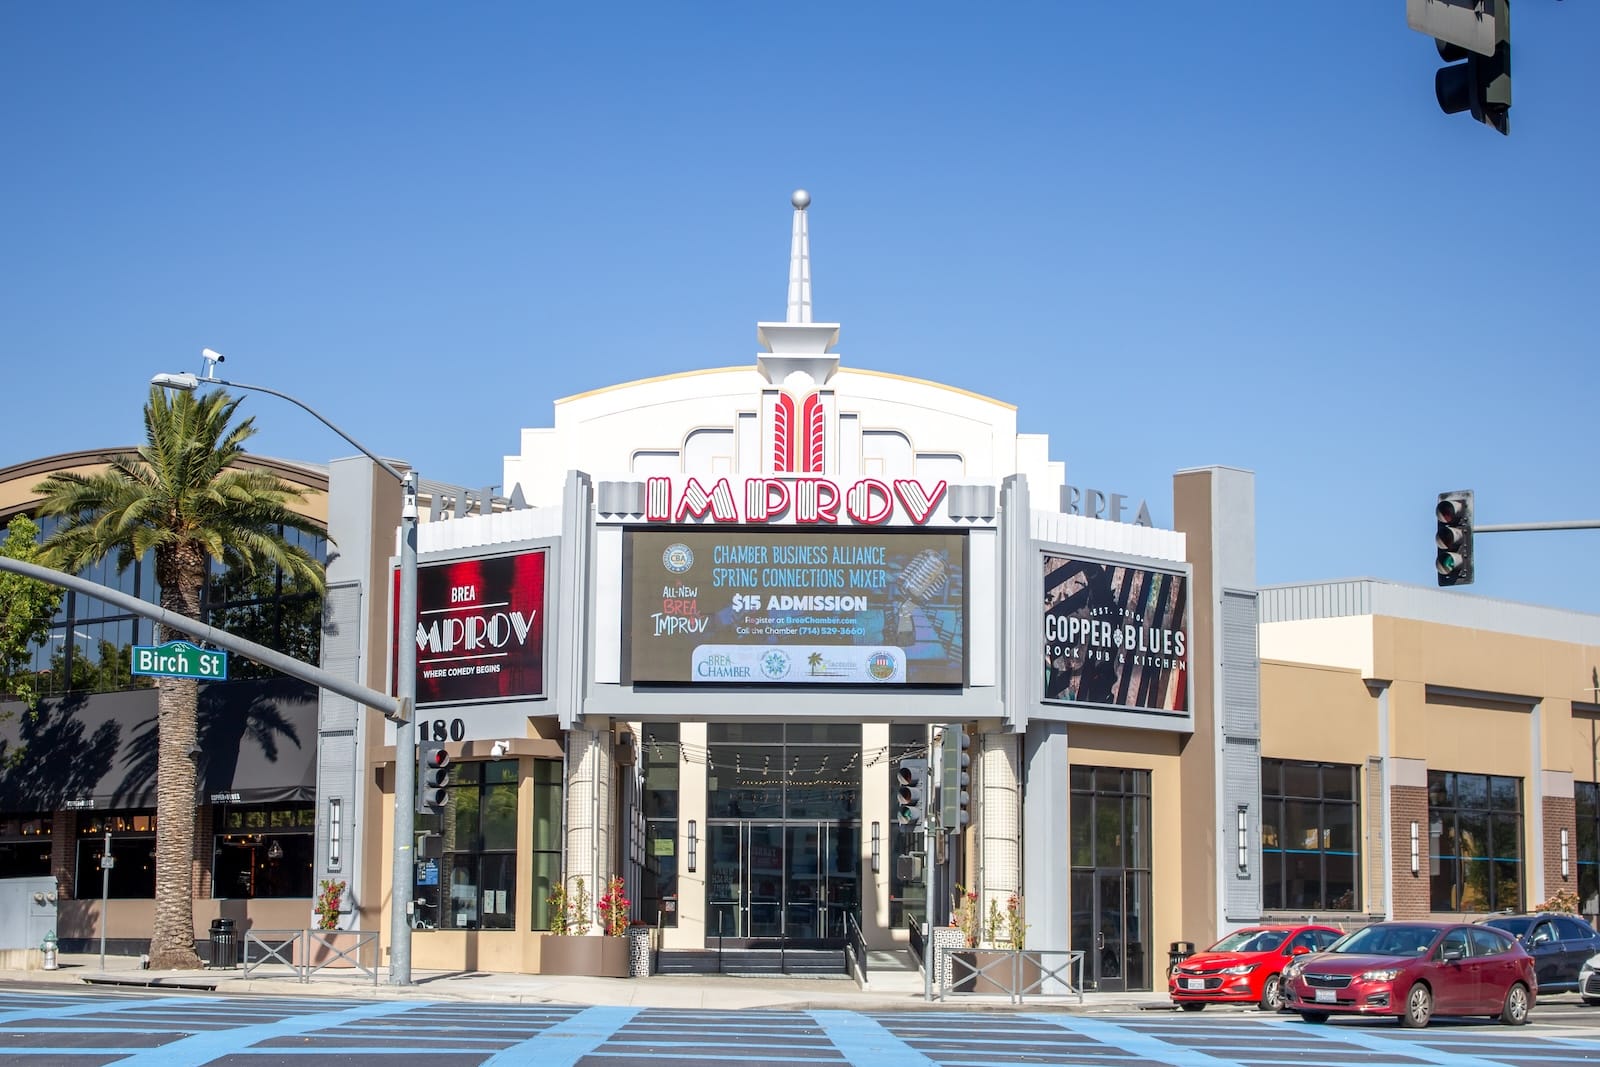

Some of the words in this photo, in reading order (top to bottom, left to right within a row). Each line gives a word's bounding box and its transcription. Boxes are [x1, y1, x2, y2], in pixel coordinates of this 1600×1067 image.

[646, 477, 947, 524] IMPROV
[713, 545, 768, 565] CHAMBER
[773, 545, 828, 565] BUSINESS
[832, 546, 886, 565] ALLIANCE
[712, 568, 757, 587] SPRING
[762, 568, 844, 588] CONNECTIONS
[850, 569, 886, 588] MIXER
[451, 585, 476, 603] BREA
[662, 585, 698, 598] ALL-NEW
[663, 599, 698, 615] BREA
[732, 593, 761, 612] $15
[766, 595, 868, 612] ADMISSION
[415, 609, 537, 653] MPROV
[764, 626, 798, 635] Chamber
[798, 627, 820, 635] (714)
[1045, 614, 1112, 648] COPPER
[1124, 624, 1185, 657] BLUES
[140, 650, 189, 673] Birch
[199, 654, 219, 675] St
[708, 655, 731, 666] BREA
[1046, 645, 1080, 659] ROCK
[1088, 650, 1110, 662] PUB
[1119, 654, 1126, 664] &
[1134, 655, 1186, 671] KITCHEN
[423, 669, 447, 678] WHERE
[447, 666, 475, 677] COMEDY
[476, 664, 501, 674] BEGINS
[697, 660, 751, 678] CHAMBER
[418, 718, 466, 742] 180
